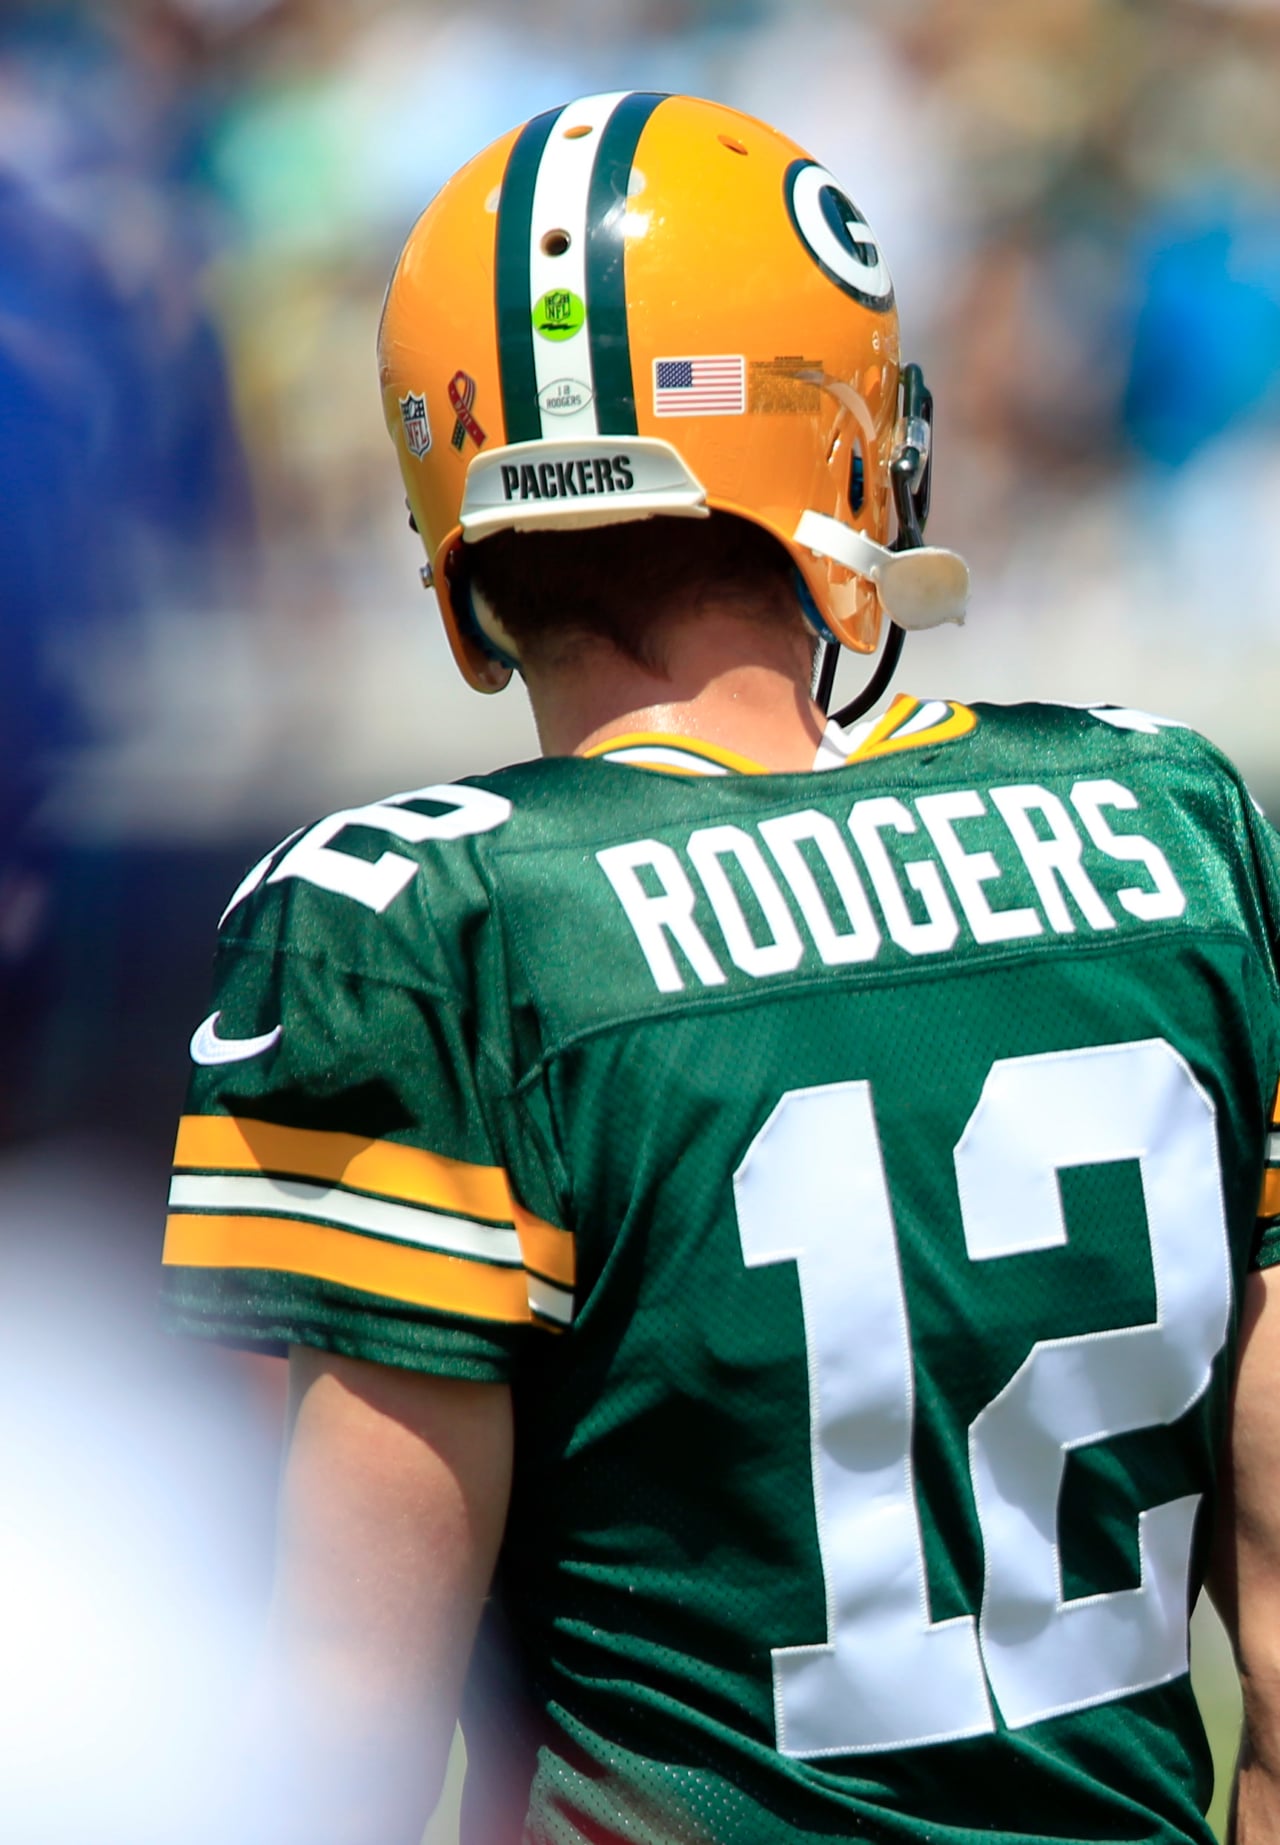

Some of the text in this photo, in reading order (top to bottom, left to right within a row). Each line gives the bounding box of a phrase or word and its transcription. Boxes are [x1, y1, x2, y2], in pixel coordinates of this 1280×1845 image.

[792, 166, 892, 297] G
[546, 303, 571, 320] NFL
[405, 419, 429, 450] NFL
[501, 455, 634, 501] PACKERS
[596, 779, 1186, 993] RODGERS
[733, 1037, 1231, 1759] 12
